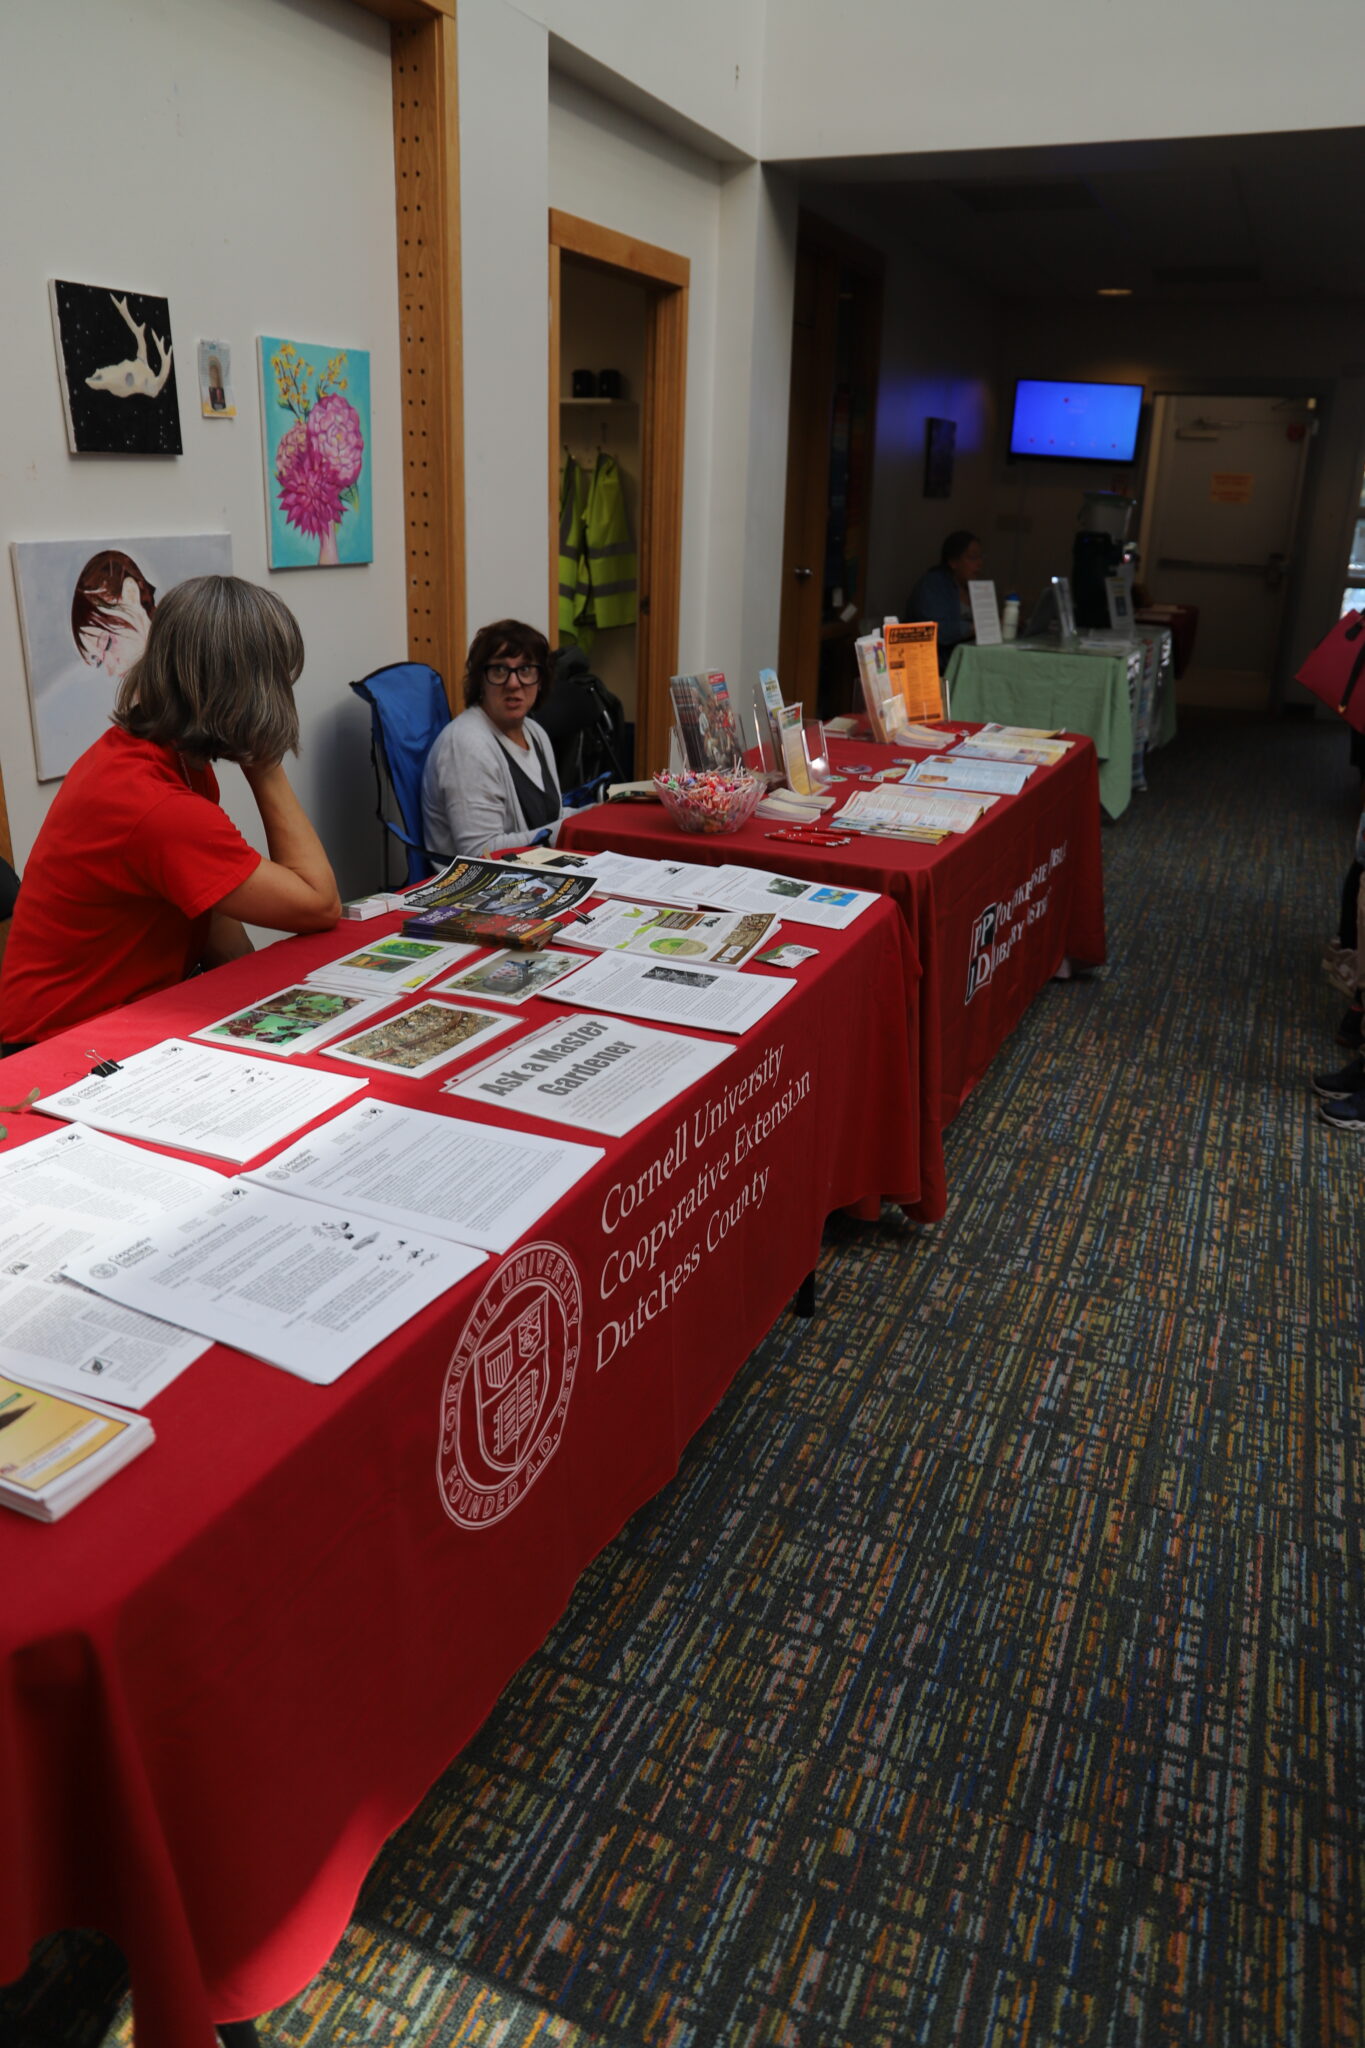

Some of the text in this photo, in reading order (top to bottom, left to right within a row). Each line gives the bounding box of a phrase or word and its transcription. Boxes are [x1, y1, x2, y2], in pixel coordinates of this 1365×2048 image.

[479, 1019, 609, 1096] Ask a Master
[537, 1039, 637, 1096] Gardener
[602, 1121, 688, 1234] Cornell
[694, 1040, 785, 1150] University
[596, 1165, 771, 1373] Dutchess County
[599, 1150, 731, 1301] Cooperative
[733, 1071, 812, 1168] Extension
[443, 1250, 580, 1455] CORNELL UNIVERSITY
[444, 1463, 519, 1520] FOUNDED
